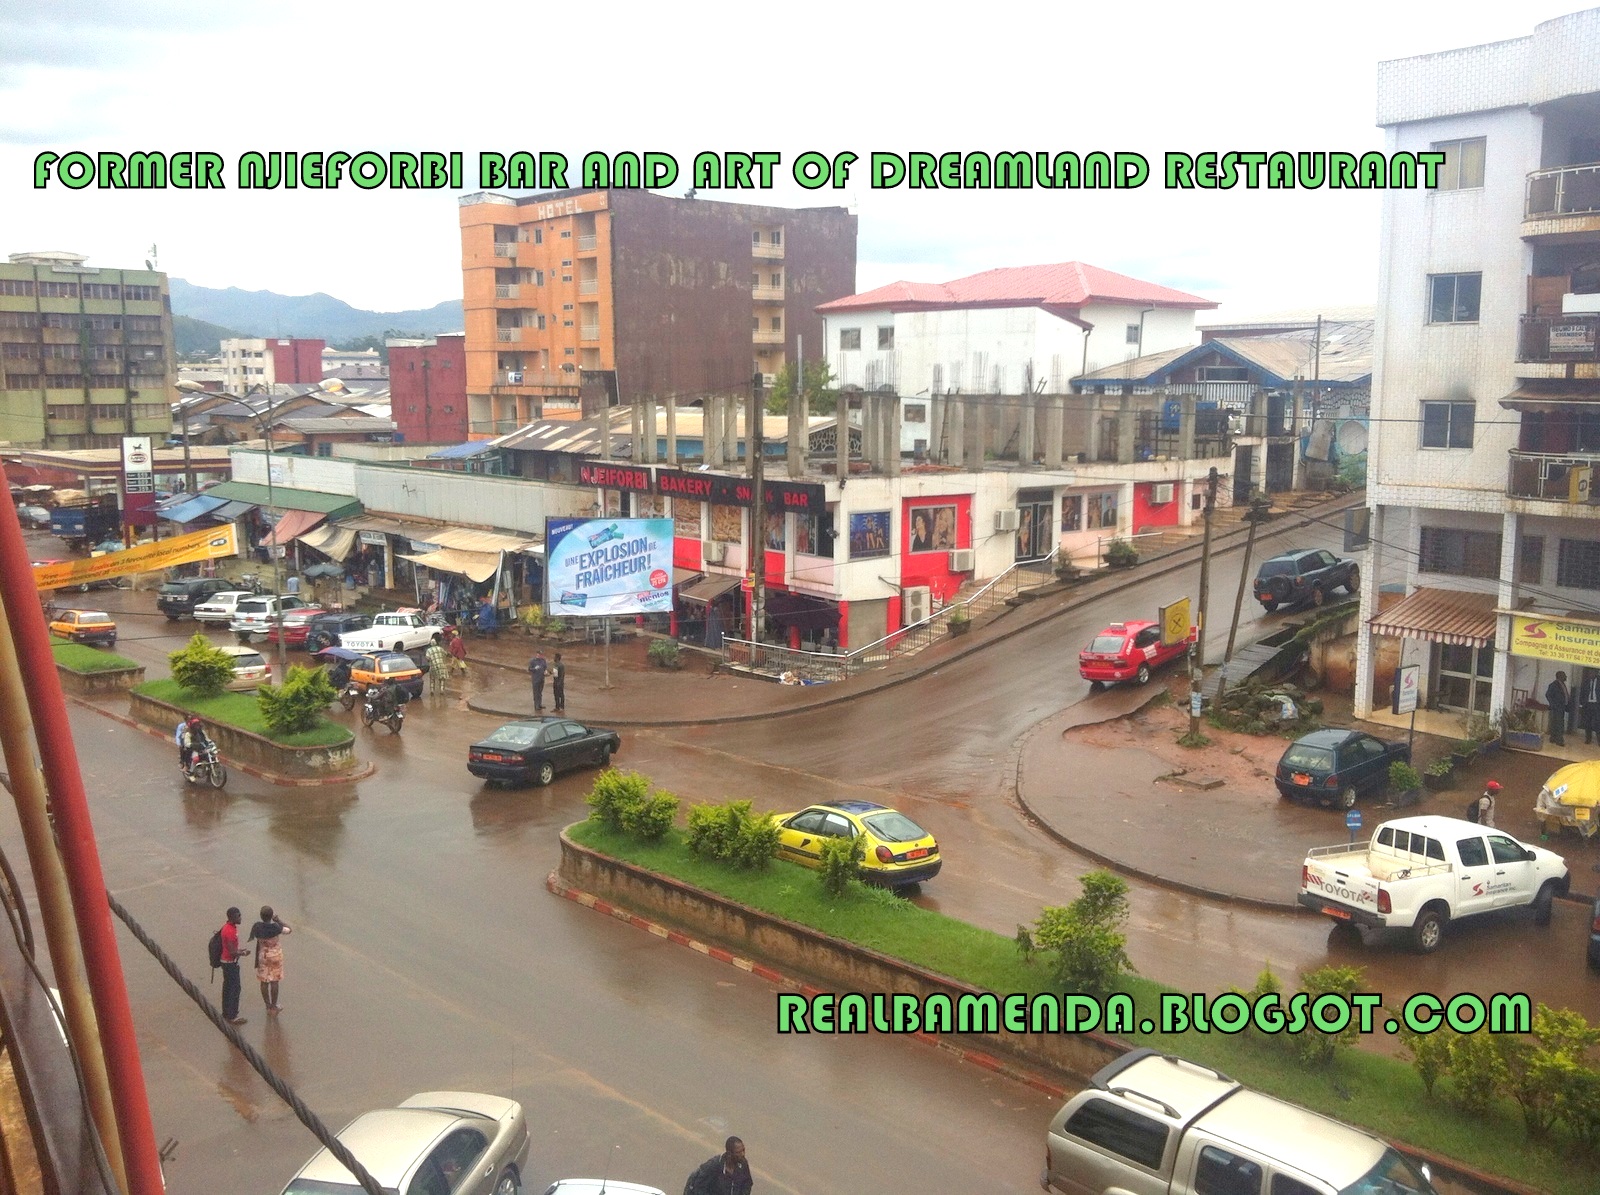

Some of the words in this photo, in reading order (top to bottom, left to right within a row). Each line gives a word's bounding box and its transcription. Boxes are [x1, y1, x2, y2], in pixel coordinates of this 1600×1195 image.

[538, 199, 583, 220] HOTEL
[580, 466, 648, 490] NJEIFORBI
[660, 476, 712, 495] BAKERY
[736, 485, 773, 503] SNK
[784, 491, 809, 507] BAR
[124, 552, 157, 564] favourite
[156, 547, 173, 559] local
[173, 542, 201, 553] numbers
[564, 555, 579, 567] UNE
[579, 537, 647, 571] EXPLOSION
[648, 541, 657, 551] DE
[576, 553, 652, 590] FRAÎCHEUR!
[640, 591, 670, 603] mentos
[1515, 638, 1548, 650] Compagnie
[1320, 881, 1365, 904] TOYOTA
